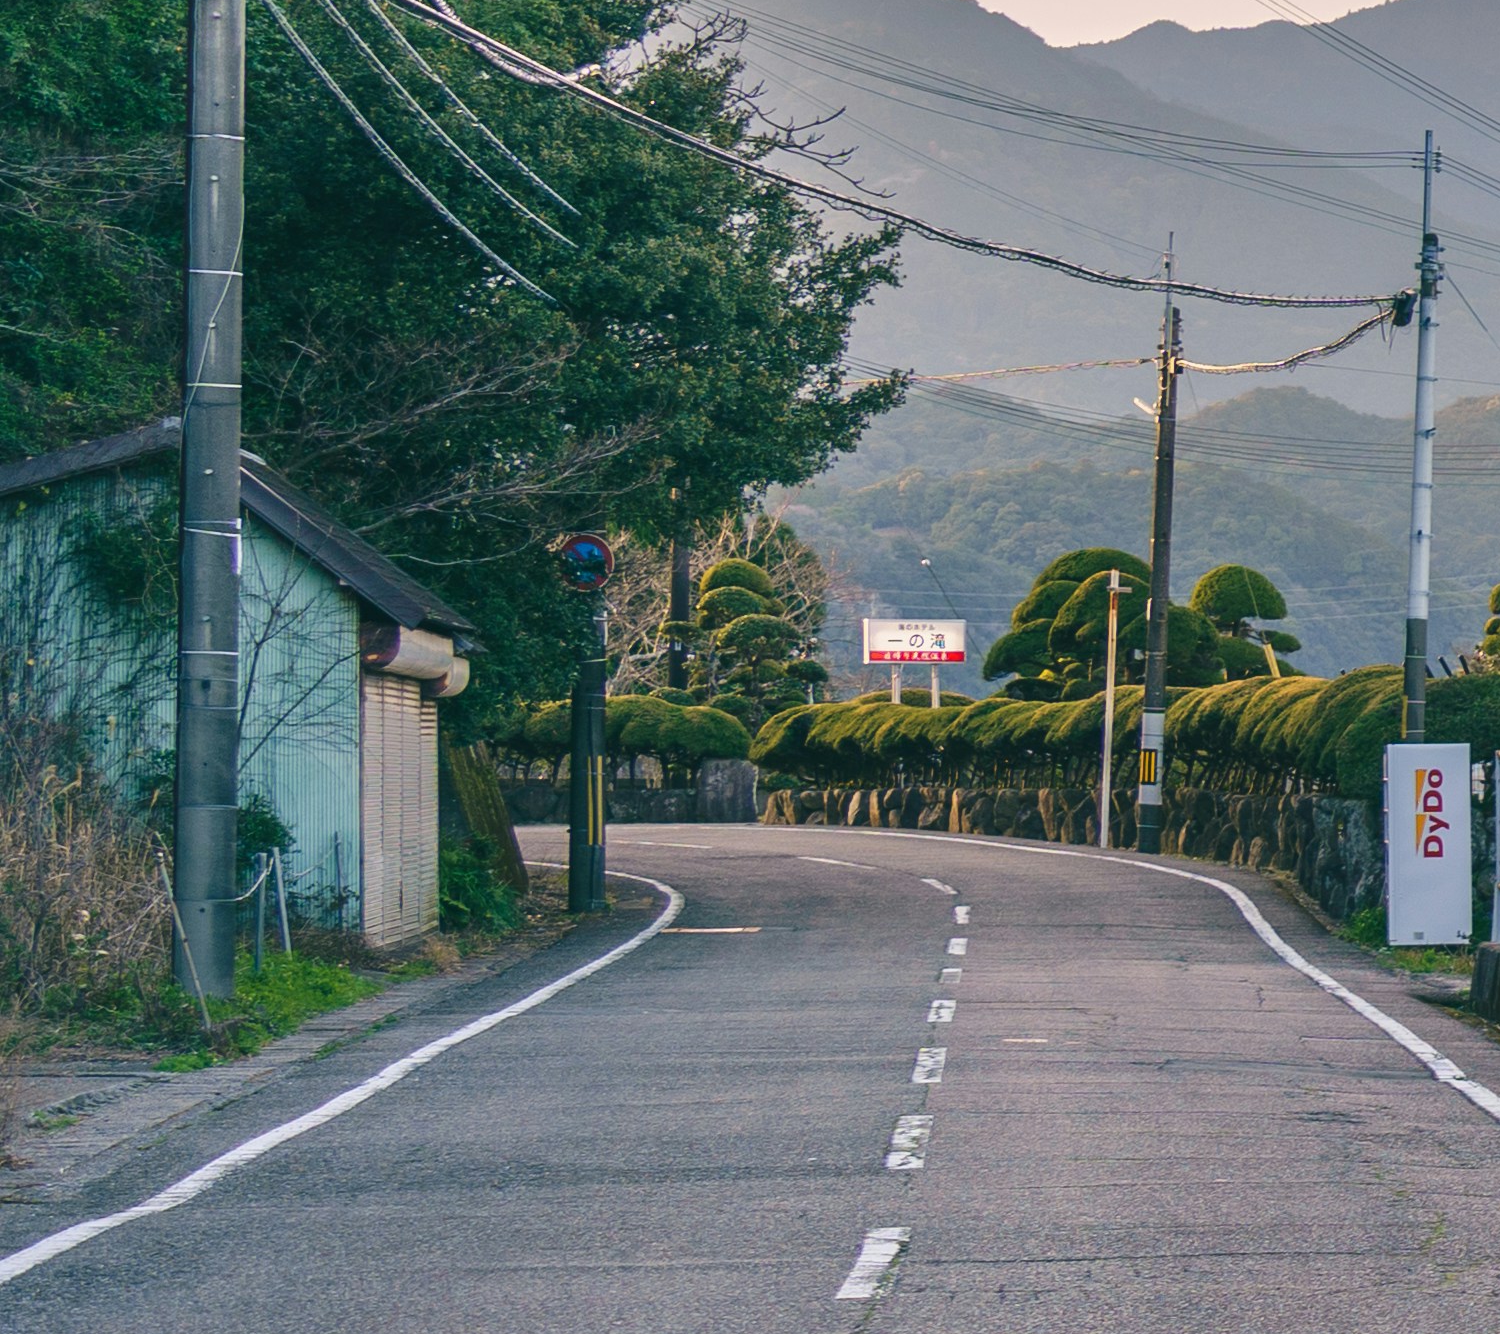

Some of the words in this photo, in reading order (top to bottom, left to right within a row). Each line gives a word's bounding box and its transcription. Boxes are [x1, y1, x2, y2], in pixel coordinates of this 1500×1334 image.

[888, 633, 946, 650] 一の滝
[1423, 768, 1450, 858] DyDo
